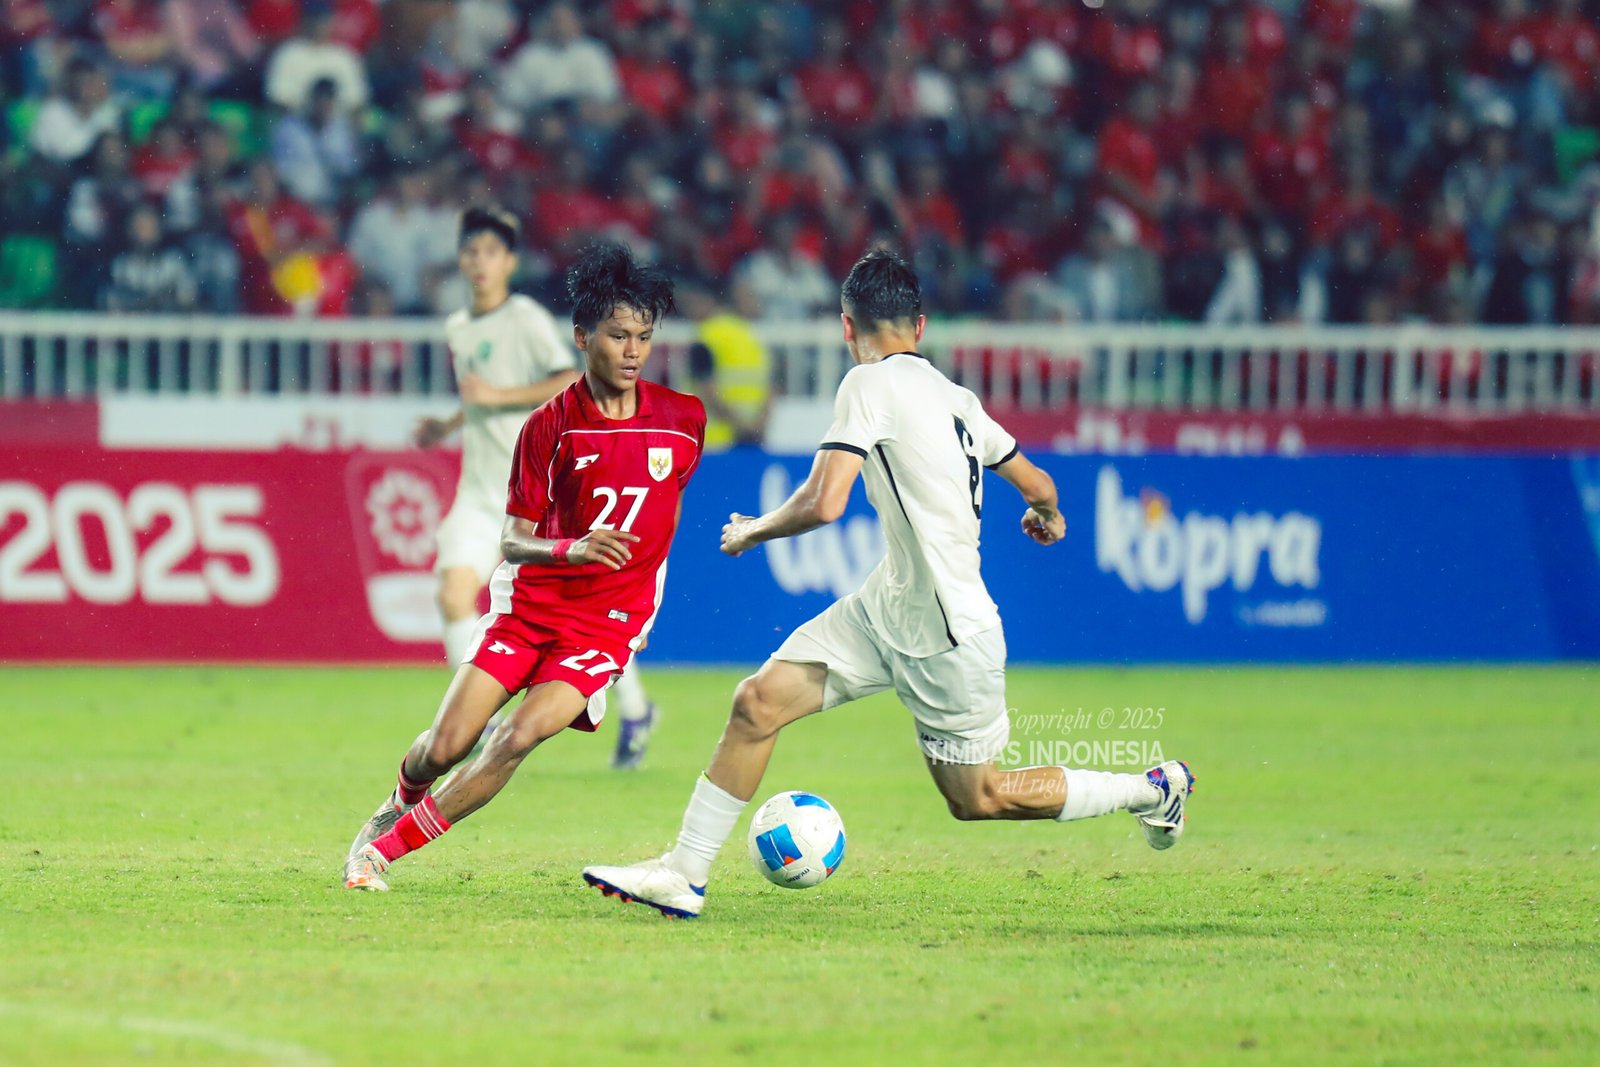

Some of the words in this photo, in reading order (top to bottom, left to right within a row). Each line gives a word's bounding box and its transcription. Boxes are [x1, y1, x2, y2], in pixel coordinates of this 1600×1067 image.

[0, 481, 279, 606] 2025
[589, 486, 649, 532] 27
[1095, 465, 1321, 625] kopra
[559, 648, 621, 677] 27
